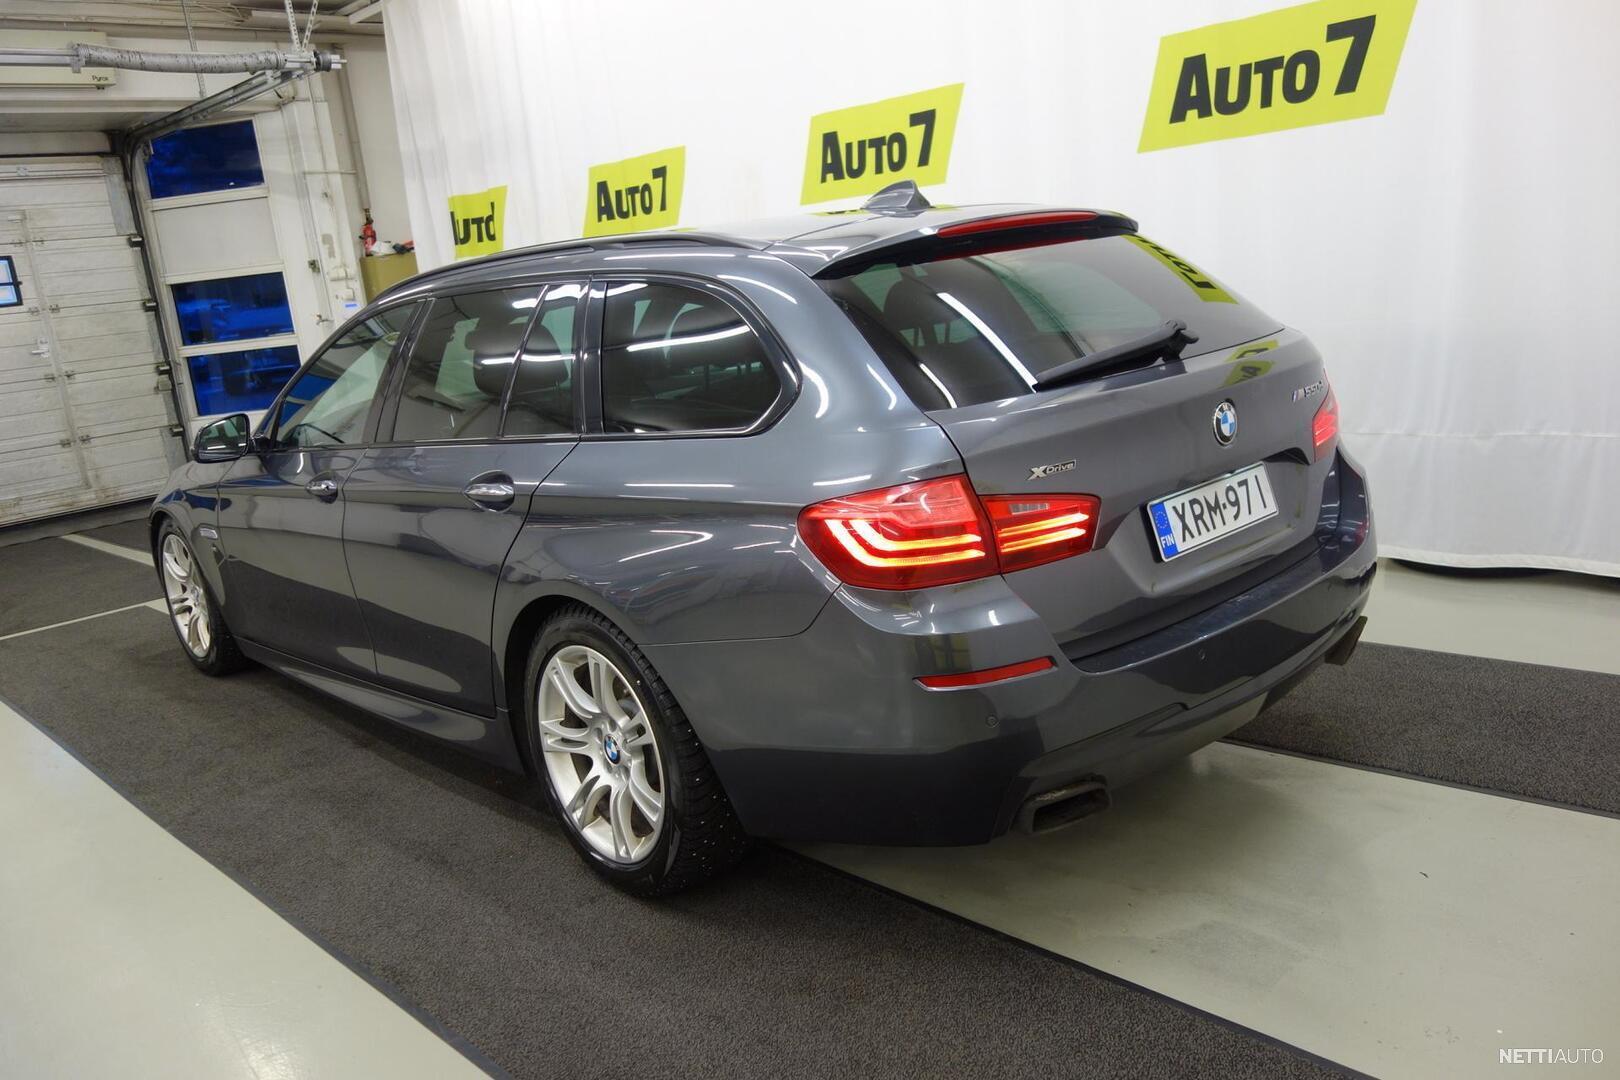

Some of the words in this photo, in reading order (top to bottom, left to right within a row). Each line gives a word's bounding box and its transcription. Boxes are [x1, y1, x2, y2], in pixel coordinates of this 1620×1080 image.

[1325, 14, 1377, 96] 7
[909, 108, 936, 168] 7
[652, 165, 667, 212] 7
[1172, 475, 1267, 543] XRM-971
[1160, 533, 1175, 548] FIN
